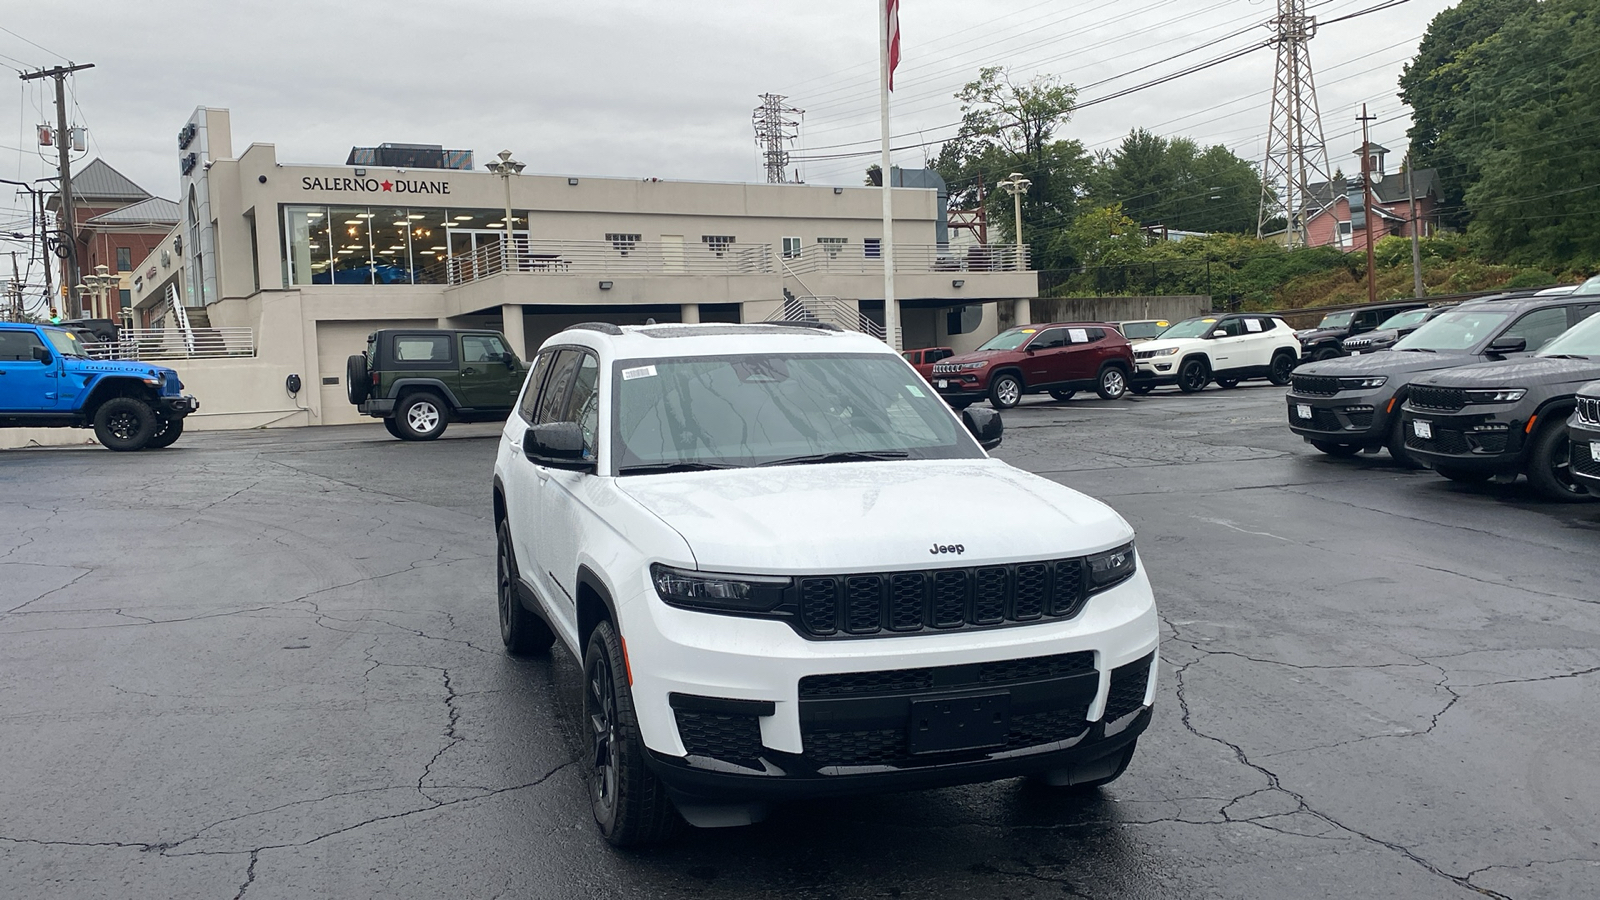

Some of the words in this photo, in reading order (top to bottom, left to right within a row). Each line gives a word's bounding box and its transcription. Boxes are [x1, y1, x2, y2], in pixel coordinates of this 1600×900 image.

[302, 176, 379, 192] SALERNO
[395, 179, 451, 194] DUANE
[929, 543, 965, 555] Jeep
